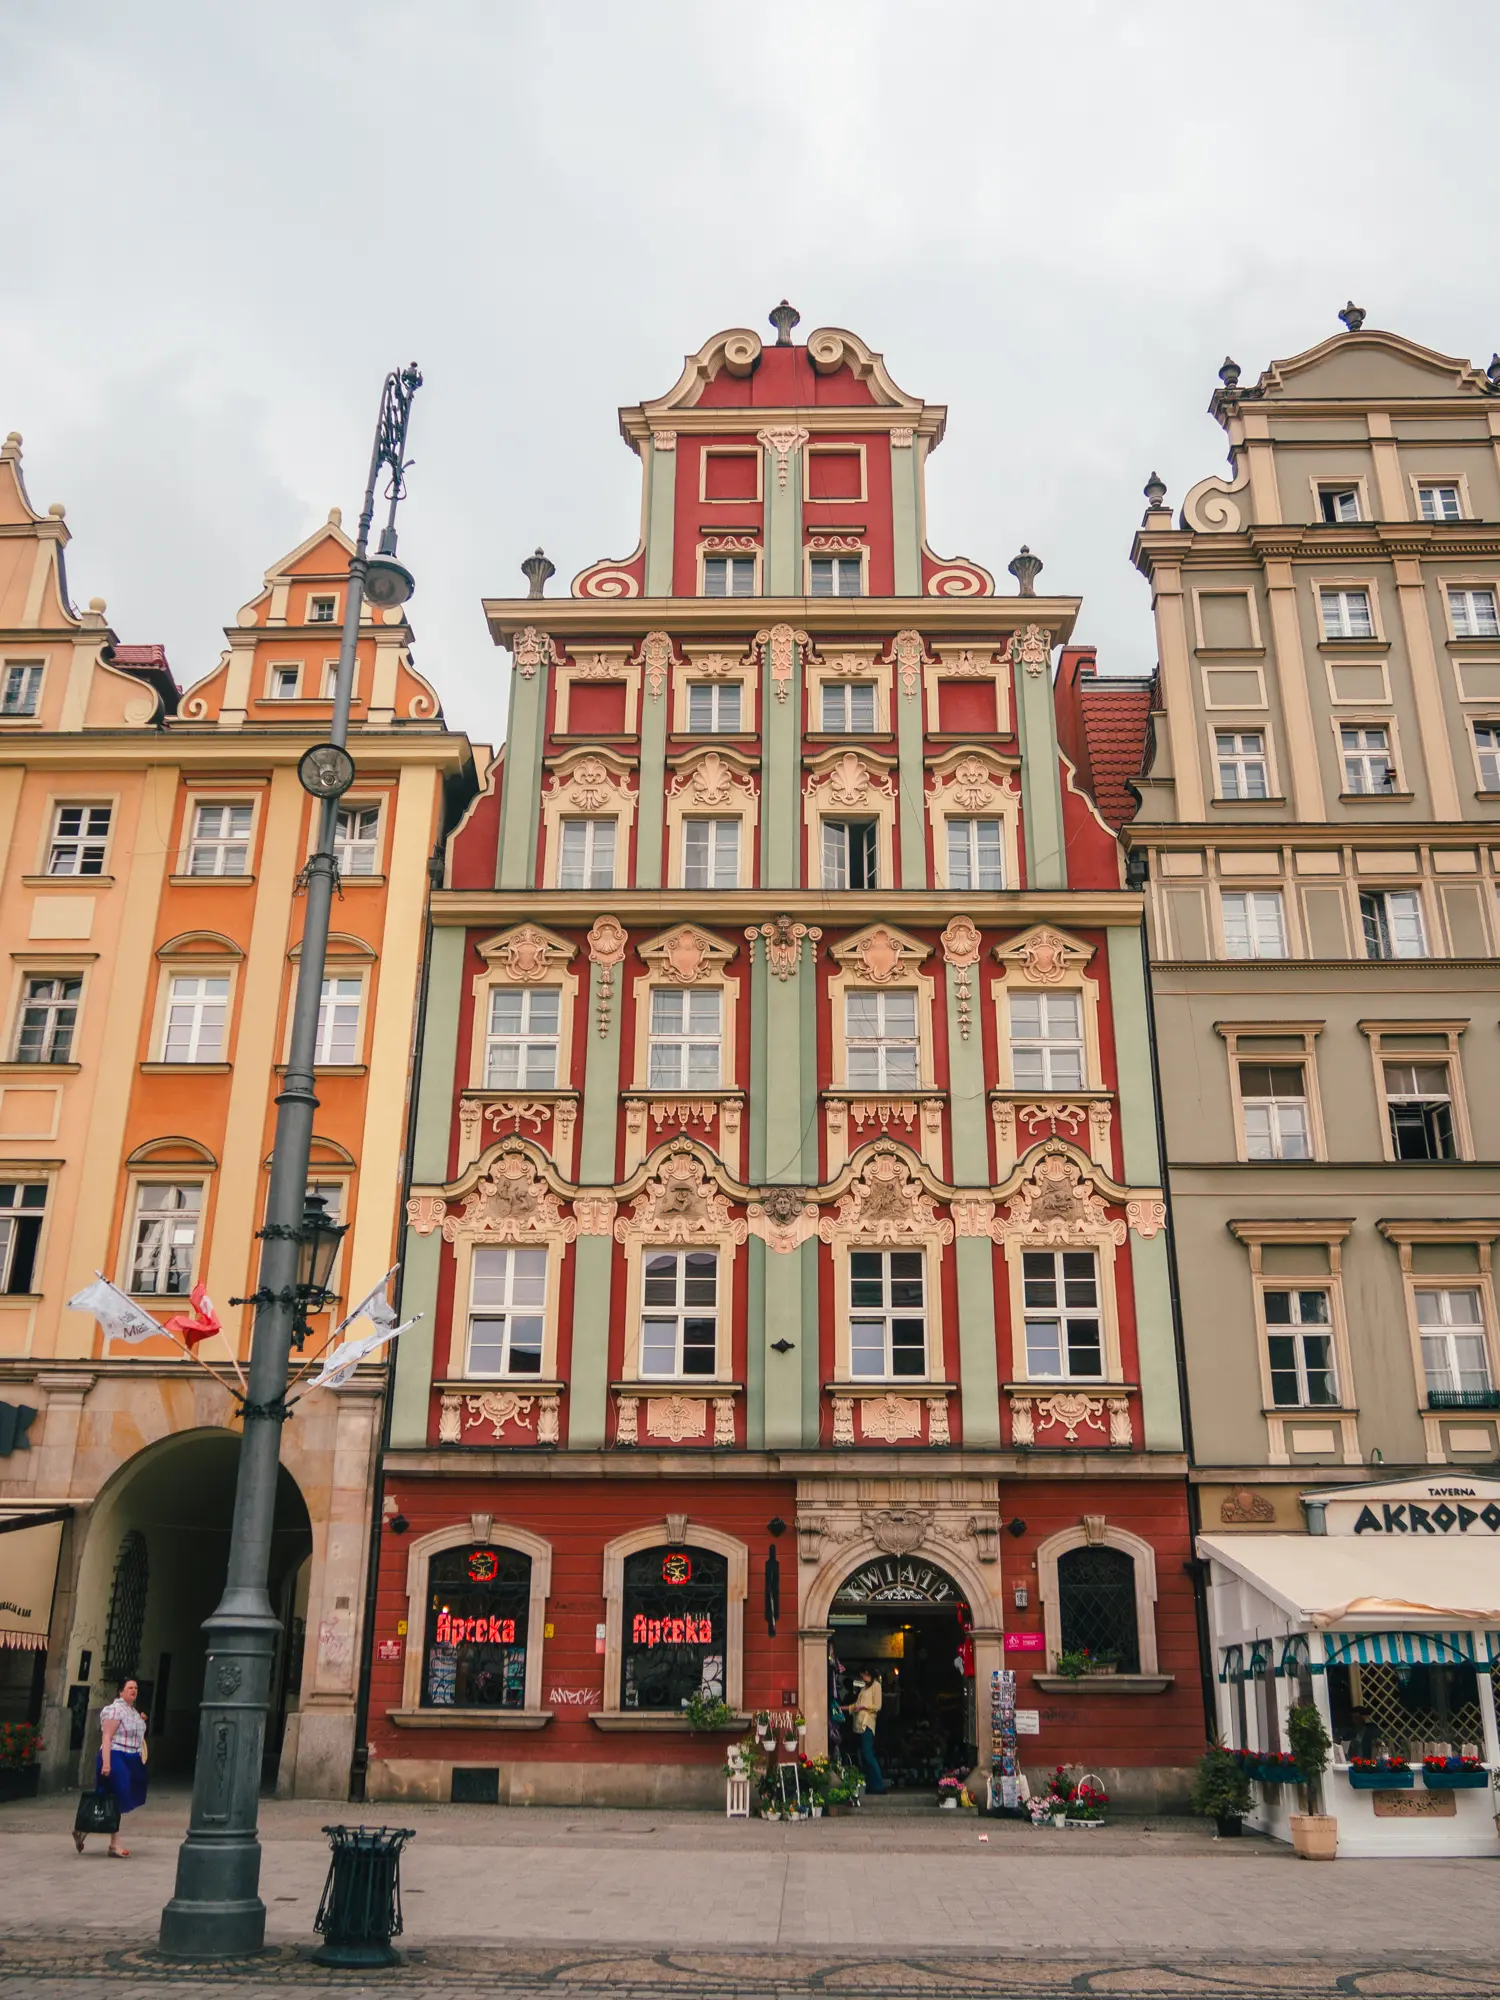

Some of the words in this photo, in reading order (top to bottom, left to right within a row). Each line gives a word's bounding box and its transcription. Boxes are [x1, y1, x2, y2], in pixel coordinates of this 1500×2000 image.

[1428, 1487, 1476, 1497] TAVERNA
[846, 1562, 954, 1602] KWIATY
[436, 1614, 515, 1646] Apteka
[633, 1614, 712, 1648] Apteka
